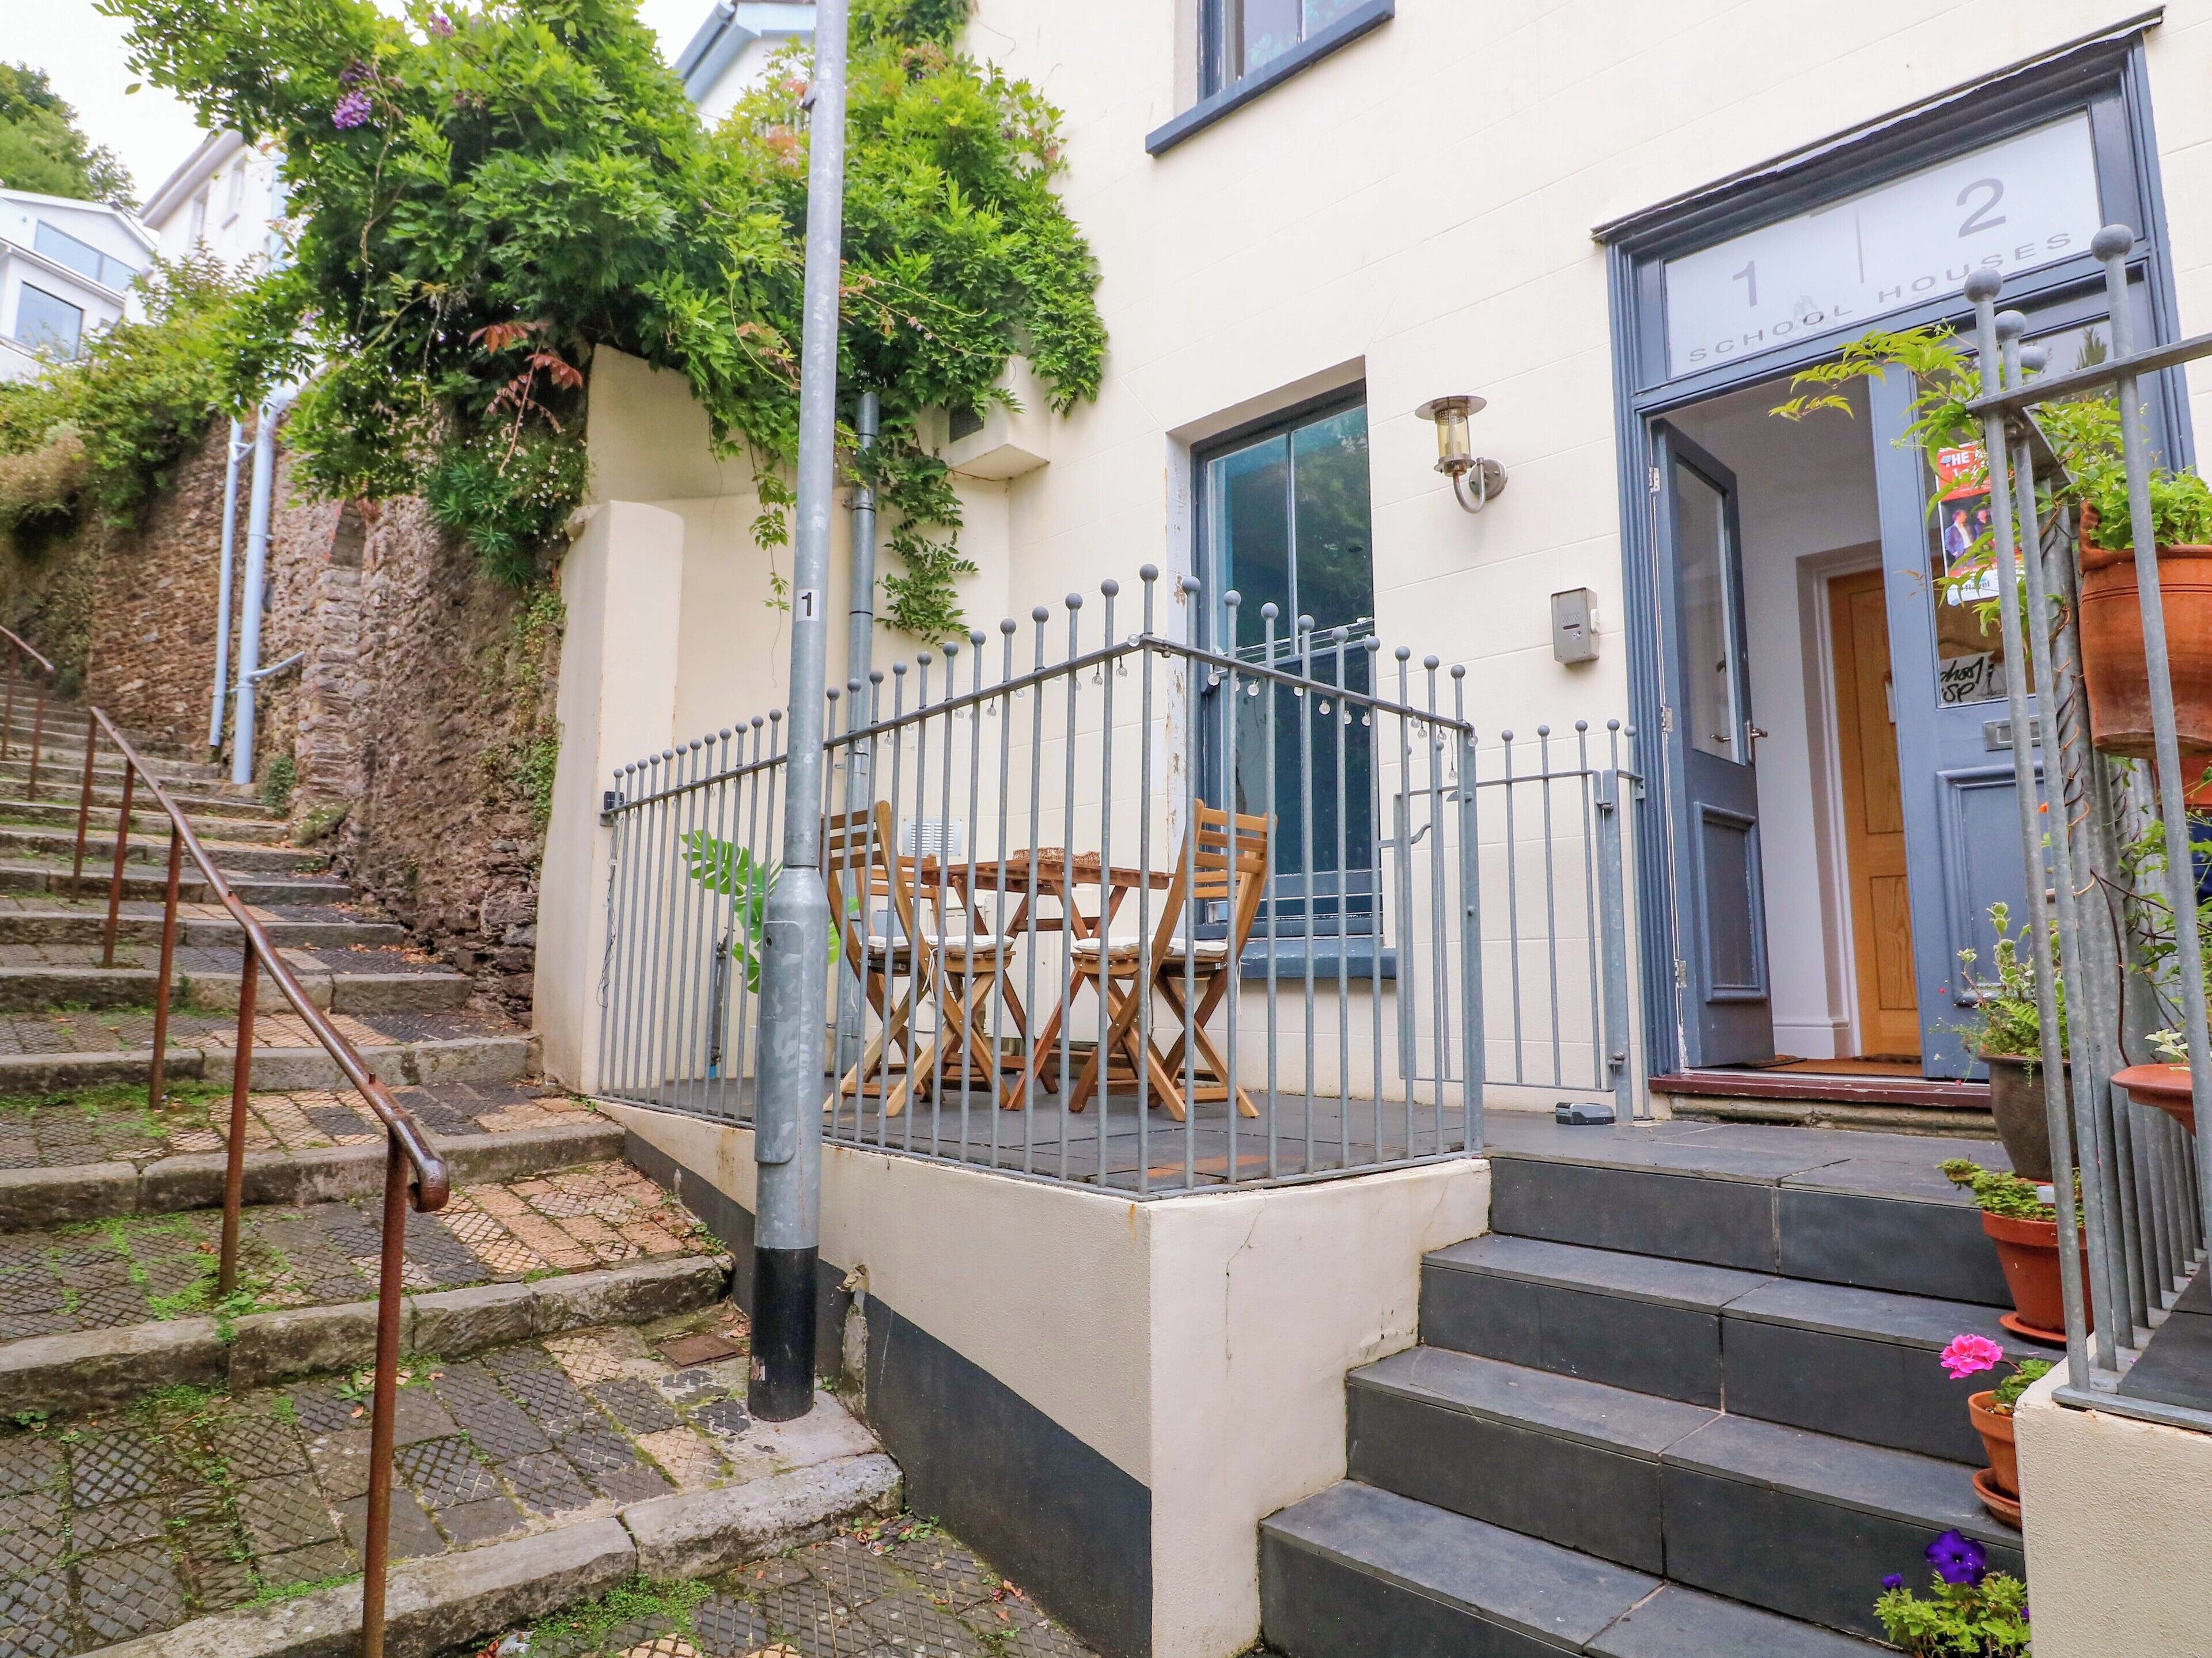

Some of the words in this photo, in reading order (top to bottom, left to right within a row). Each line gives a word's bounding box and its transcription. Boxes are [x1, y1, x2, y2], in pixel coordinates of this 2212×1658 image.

[1688, 305, 1854, 363] SCHOOL
[1878, 232, 2073, 303] HOUSES
[1732, 260, 1759, 308] 1
[1956, 178, 2006, 238] 2
[801, 592, 812, 617] 1
